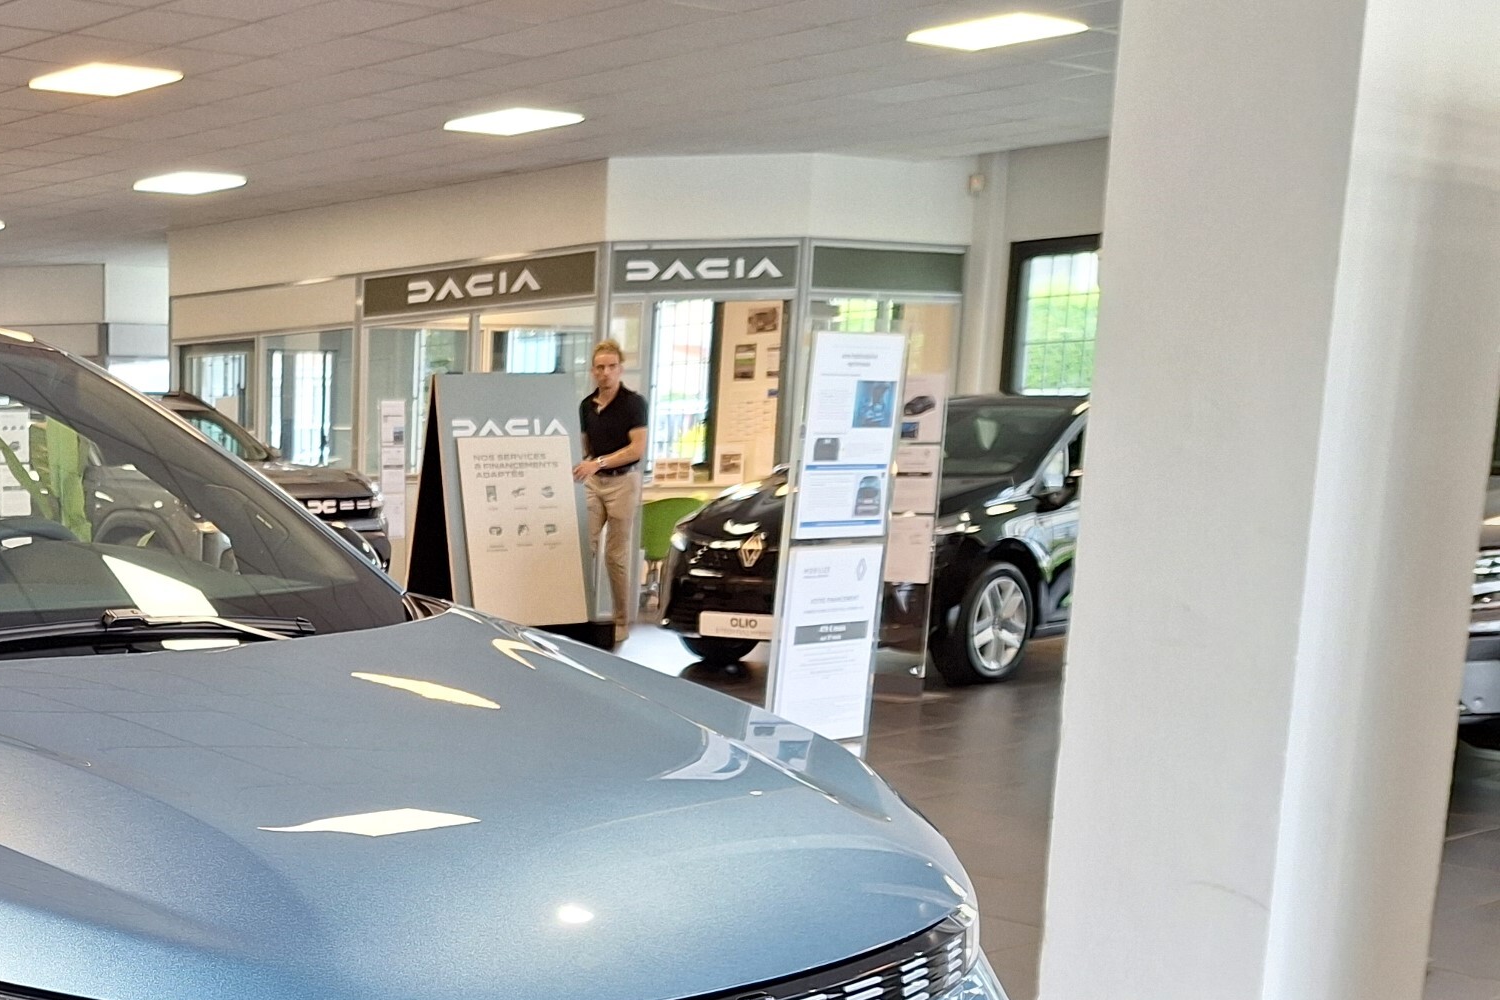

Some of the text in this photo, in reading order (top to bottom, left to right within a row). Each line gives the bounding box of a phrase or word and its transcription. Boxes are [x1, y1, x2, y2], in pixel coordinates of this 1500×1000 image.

[625, 256, 784, 281] DACIA
[407, 267, 542, 304] DACIA
[451, 418, 569, 438] DACIA
[730, 617, 758, 629] CLIO
